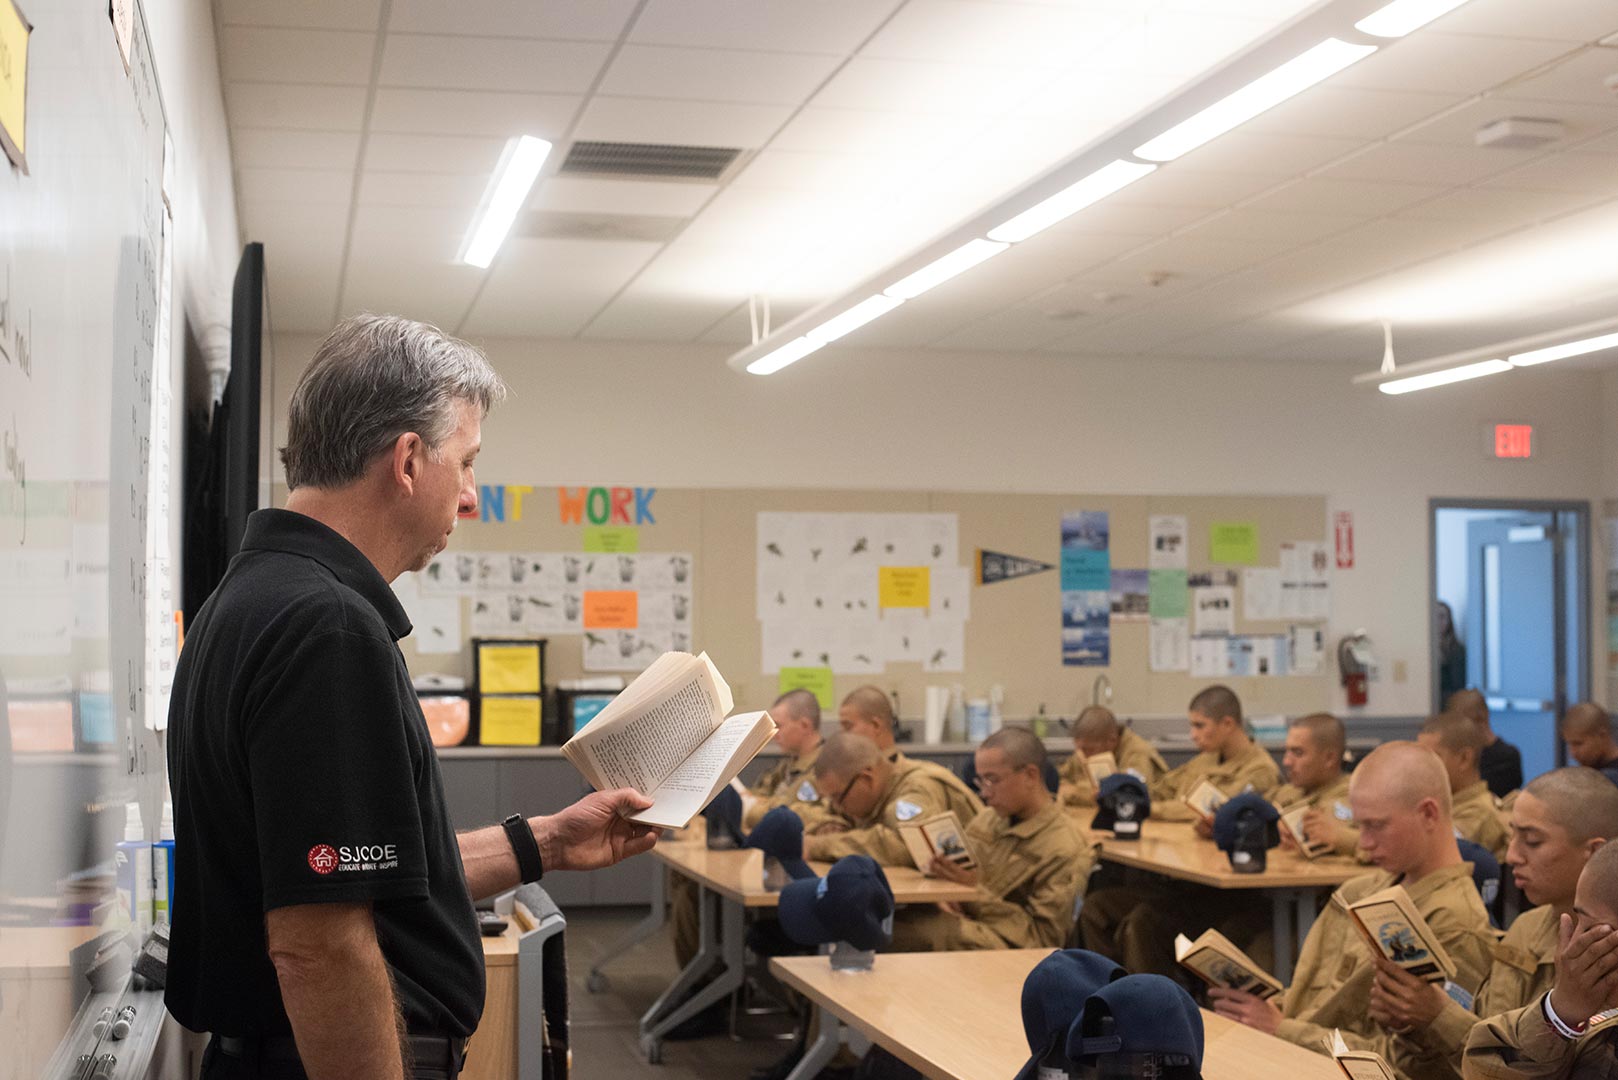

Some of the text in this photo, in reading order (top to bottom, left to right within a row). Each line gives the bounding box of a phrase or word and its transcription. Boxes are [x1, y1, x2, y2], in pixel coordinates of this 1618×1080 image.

[1495, 424, 1532, 458] EXIT
[459, 485, 656, 525] NT WORK
[339, 844, 398, 863] SJCOE
